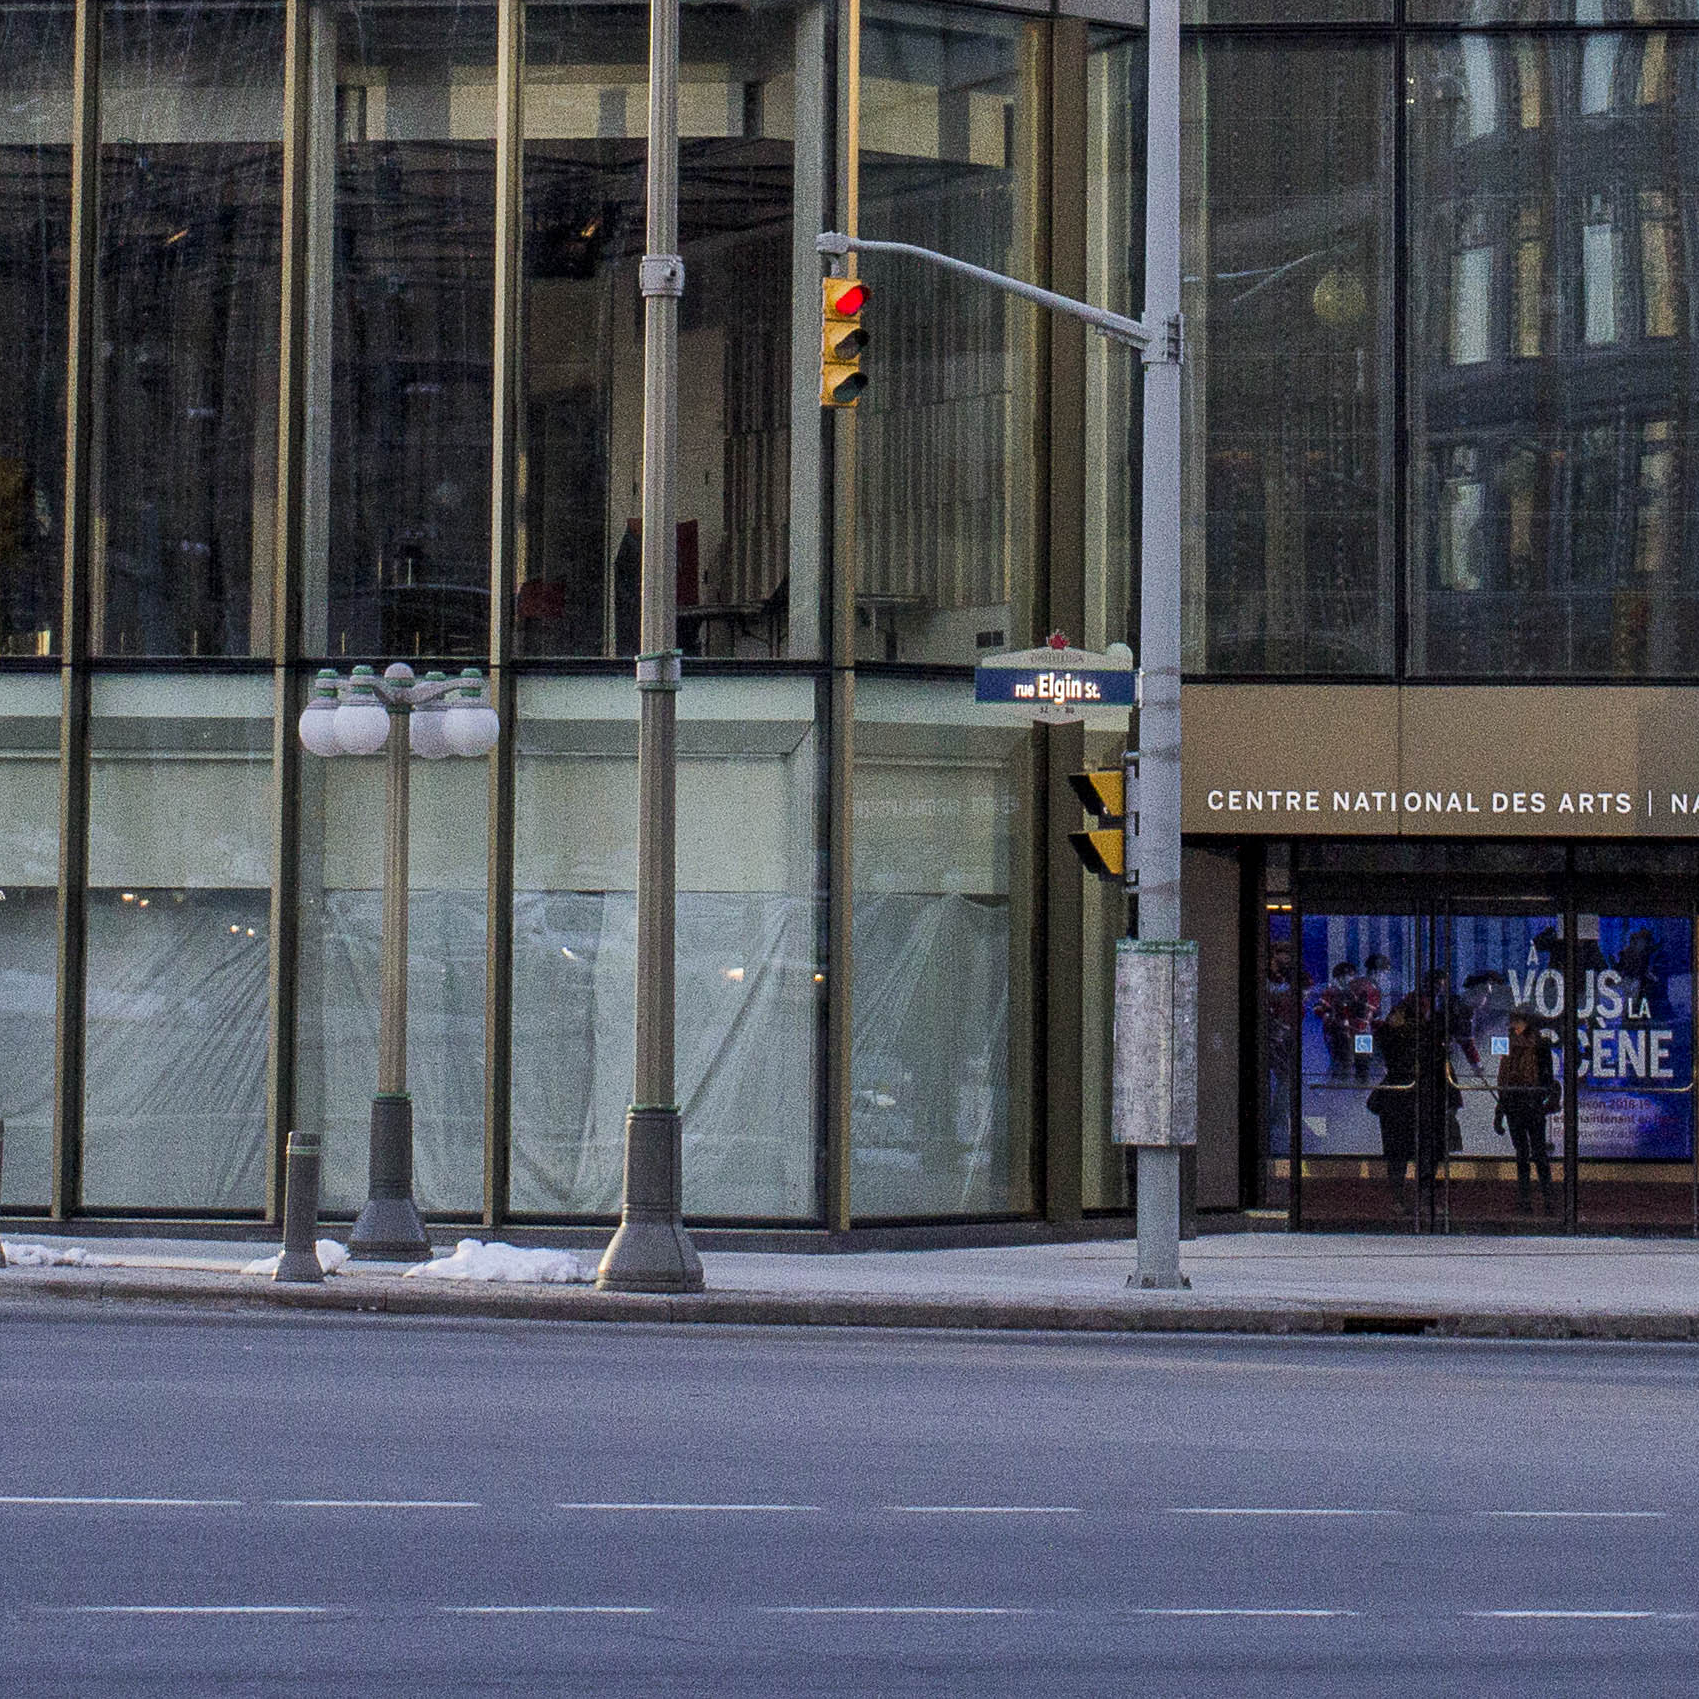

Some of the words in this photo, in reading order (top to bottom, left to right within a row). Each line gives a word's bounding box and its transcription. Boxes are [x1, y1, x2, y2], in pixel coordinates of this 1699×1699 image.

[1015, 684, 1035, 698] rue
[1038, 672, 1082, 705] Elgin
[1207, 789, 1320, 811] CENTRE
[1332, 790, 1480, 812] NATIONAL
[1491, 791, 1546, 813] DES
[1558, 792, 1632, 814] ARTS
[1508, 969, 1623, 1018] VOUS
[1627, 997, 1651, 1018] LA
